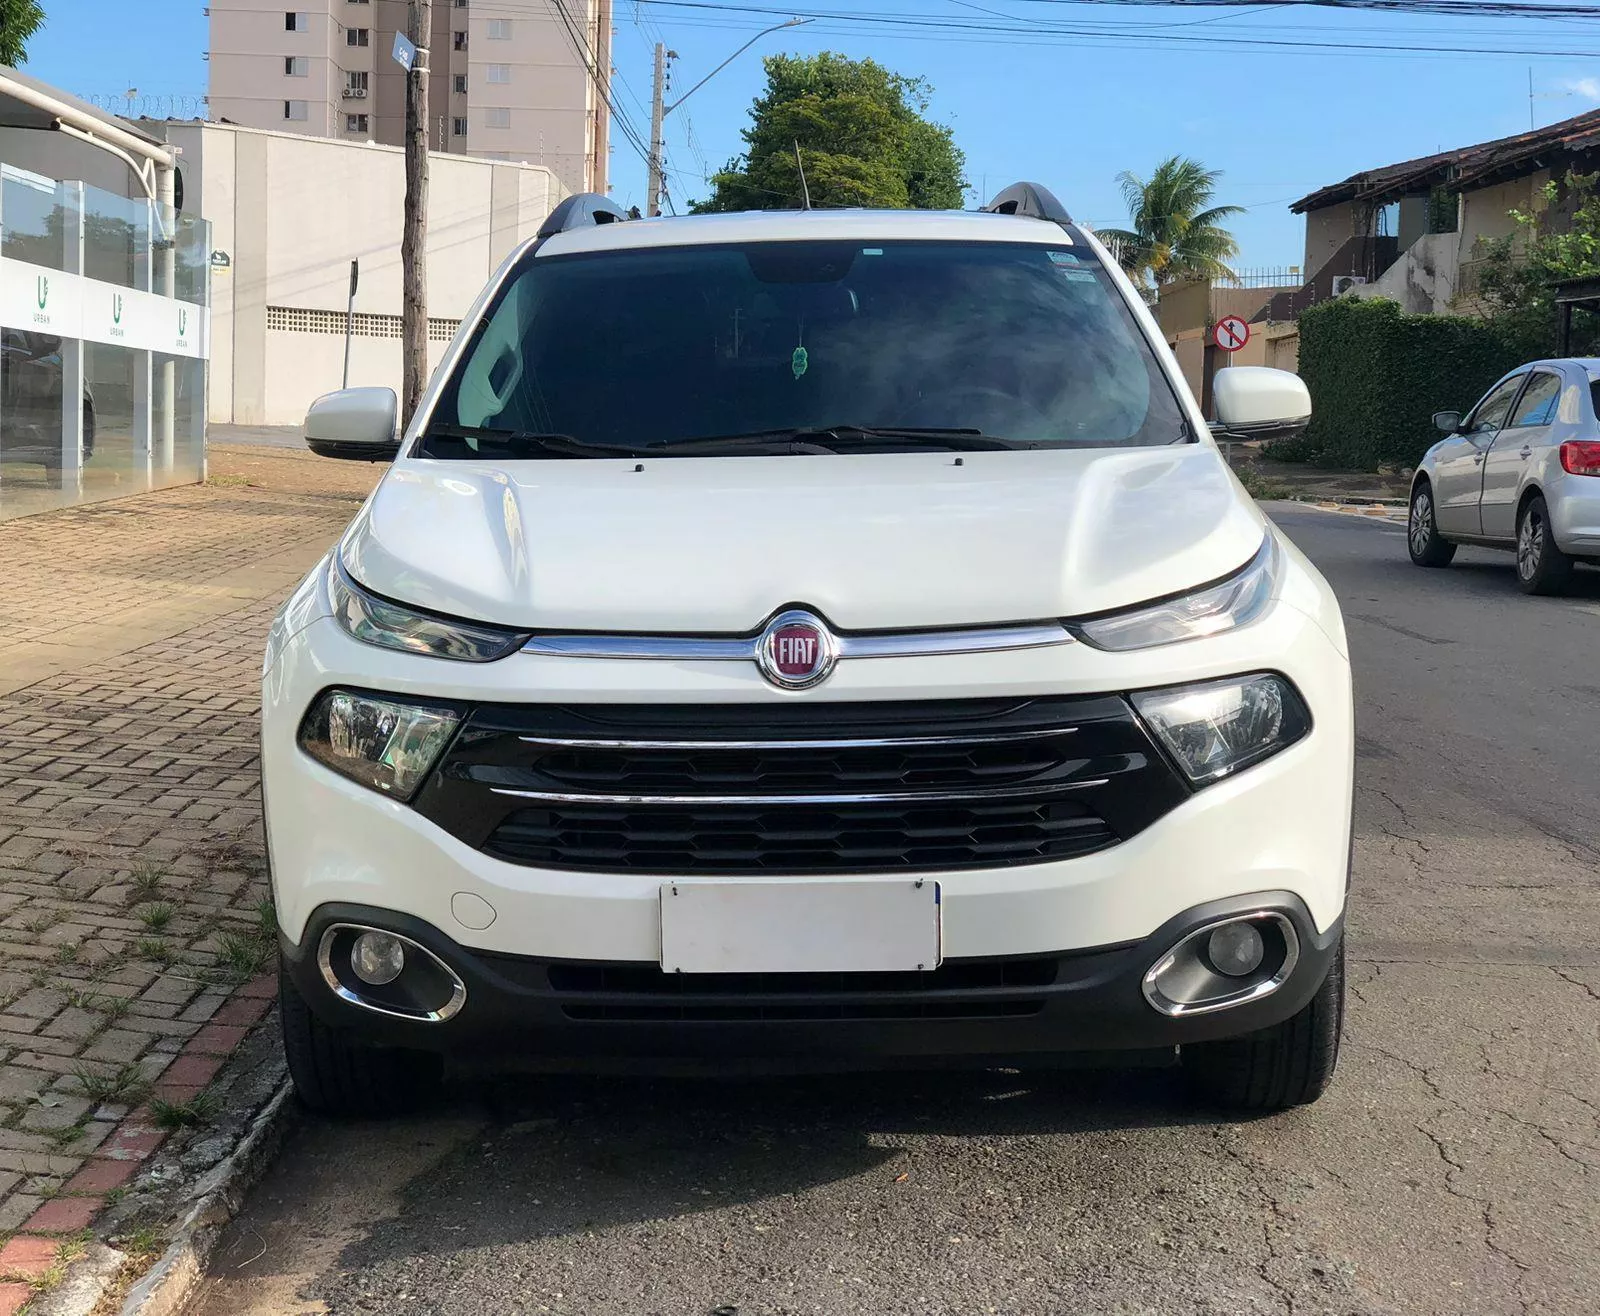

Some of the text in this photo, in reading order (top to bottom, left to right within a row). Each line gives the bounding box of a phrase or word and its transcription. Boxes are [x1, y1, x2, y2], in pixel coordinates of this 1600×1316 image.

[33, 312, 50, 324] URBAN
[110, 327, 124, 337] URBAN
[176, 339, 188, 348] URBAN
[779, 637, 816, 665] FIAT
